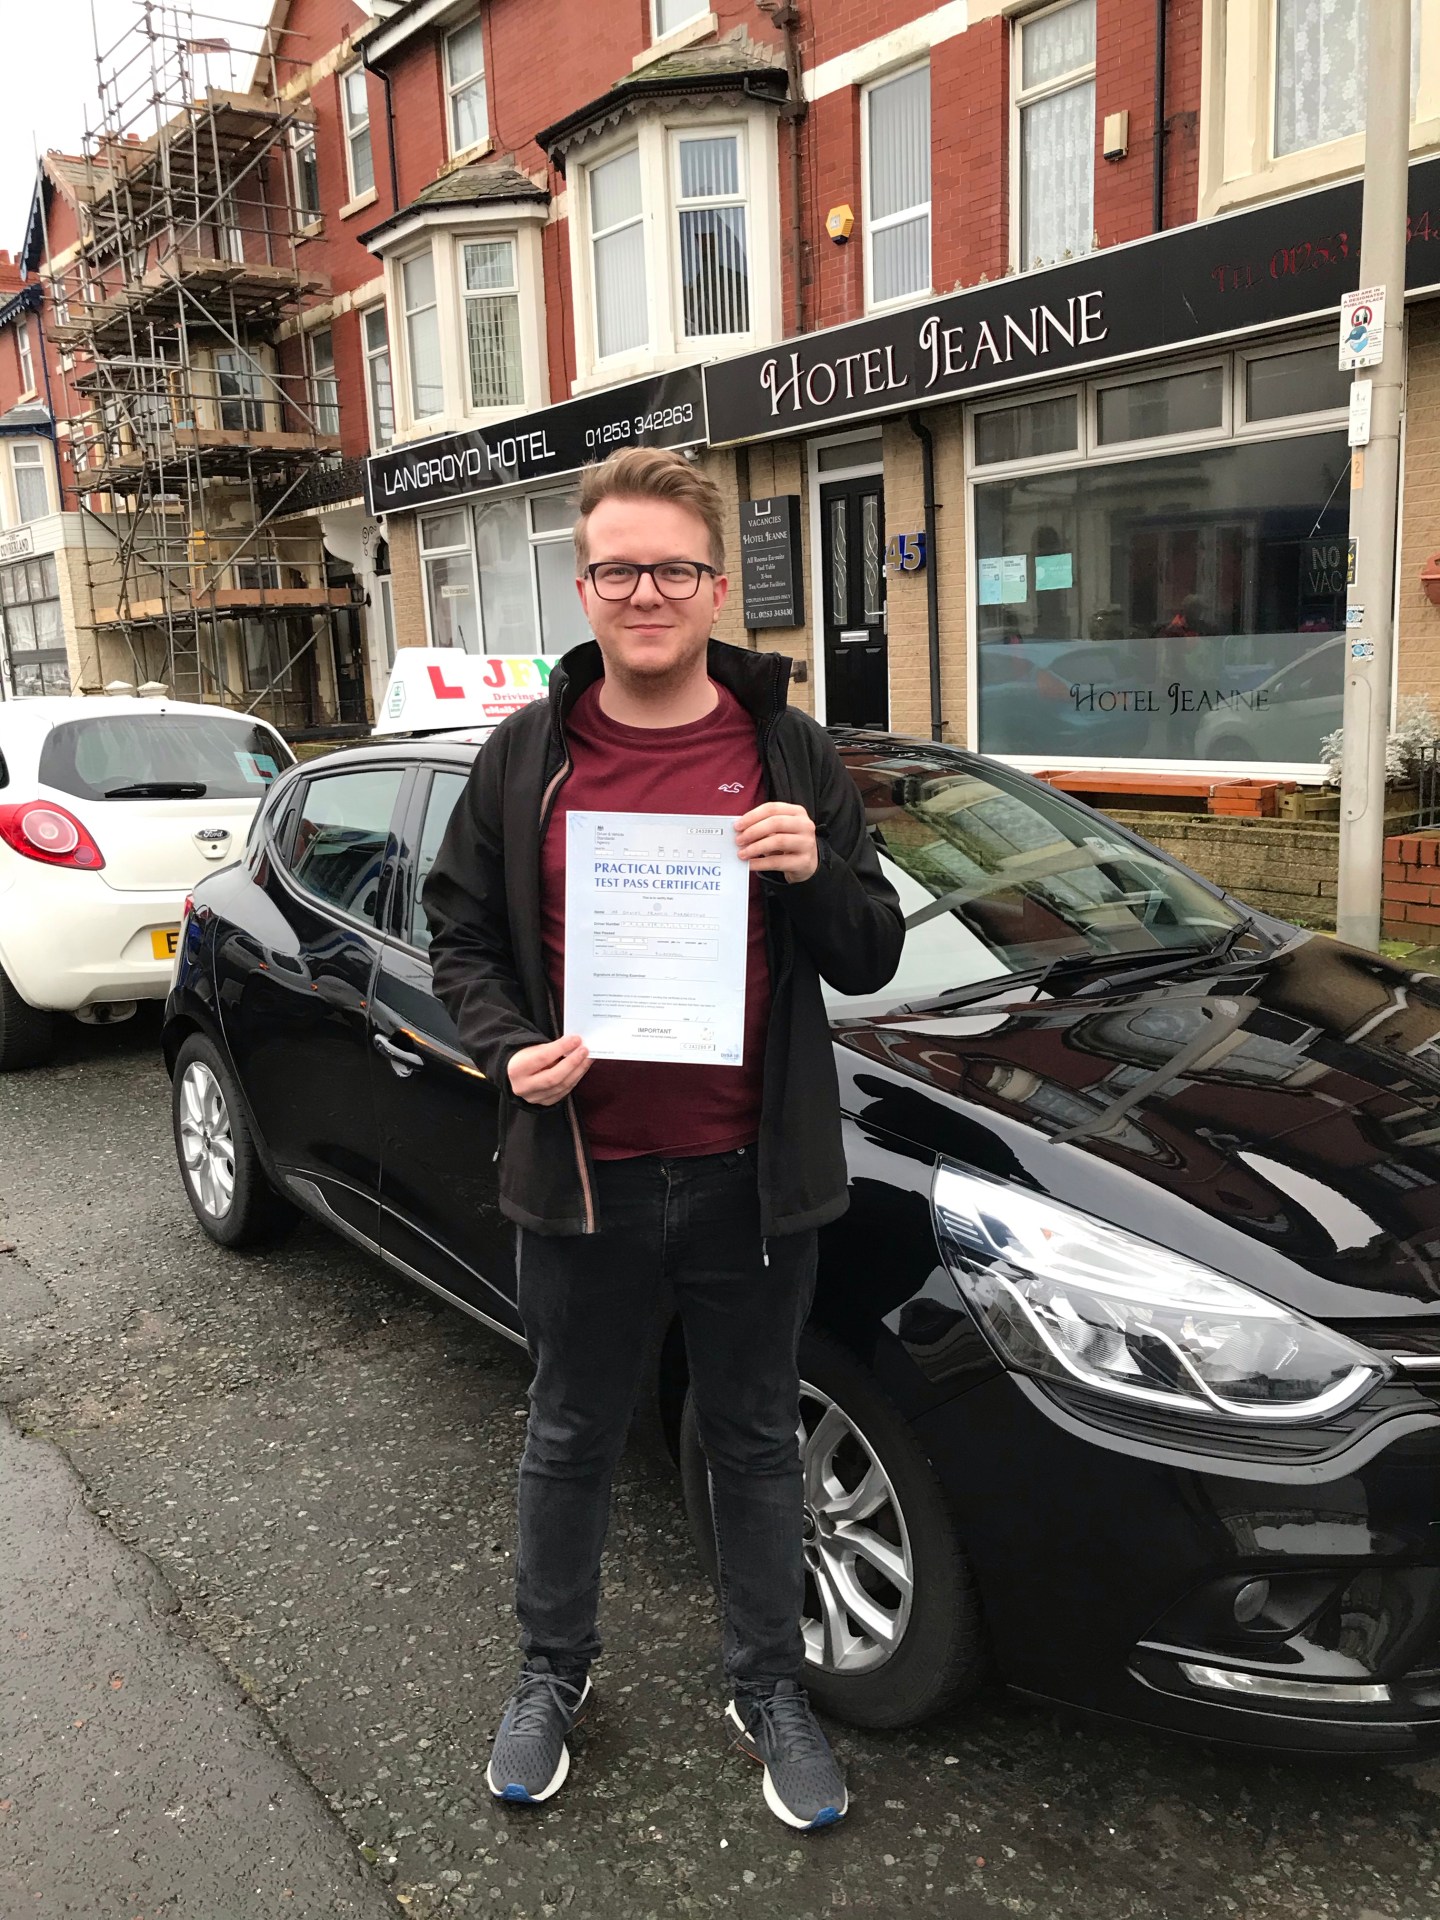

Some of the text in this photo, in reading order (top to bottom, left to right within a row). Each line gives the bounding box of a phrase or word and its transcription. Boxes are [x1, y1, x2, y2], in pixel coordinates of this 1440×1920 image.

[1343, 296, 1384, 308] PUBLIC PLACE
[1348, 291, 1385, 303] DESIGNATED
[760, 290, 1109, 416] HOTEL JEANNE
[383, 403, 694, 497] LANGROYD HOTEL 01253 342263
[747, 515, 782, 527] VACANCIES
[742, 530, 788, 545] HOTEL JEANNE
[884, 533, 922, 571] 45
[1311, 546, 1341, 570] NO
[1308, 570, 1347, 593] VAC
[427, 665, 466, 699] L
[492, 692, 536, 701] Driving
[1069, 682, 1270, 715] HOTEL JEANNE
[203, 828, 224, 838] Ford
[594, 862, 722, 877] PRACTICAL DRIVING
[594, 877, 721, 891] TEST PASS CERTIFICATE
[637, 1027, 672, 1035] IMPORTANT
